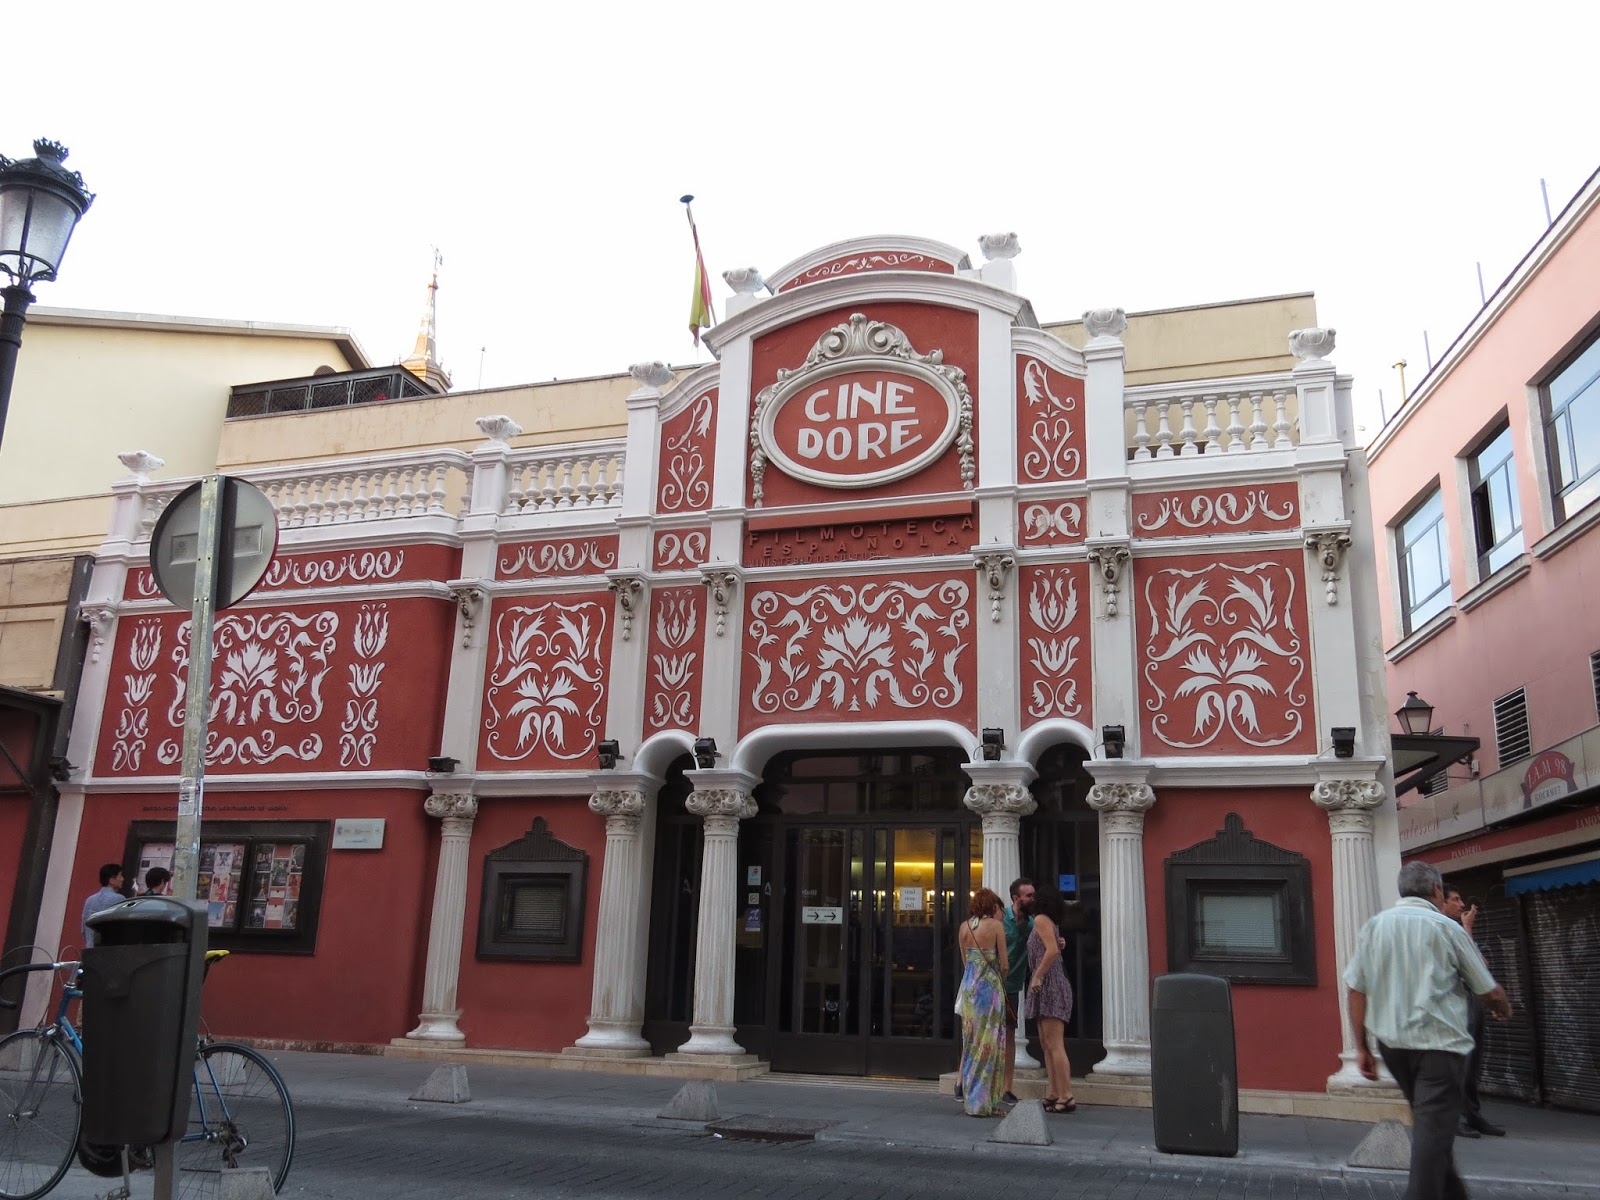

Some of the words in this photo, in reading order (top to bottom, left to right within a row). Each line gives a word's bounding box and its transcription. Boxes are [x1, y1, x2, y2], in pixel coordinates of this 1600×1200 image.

[805, 381, 915, 422] CINE
[798, 419, 922, 461] DORE
[750, 518, 973, 546] FILMOTECA
[763, 534, 957, 557] ESPAÑOLA
